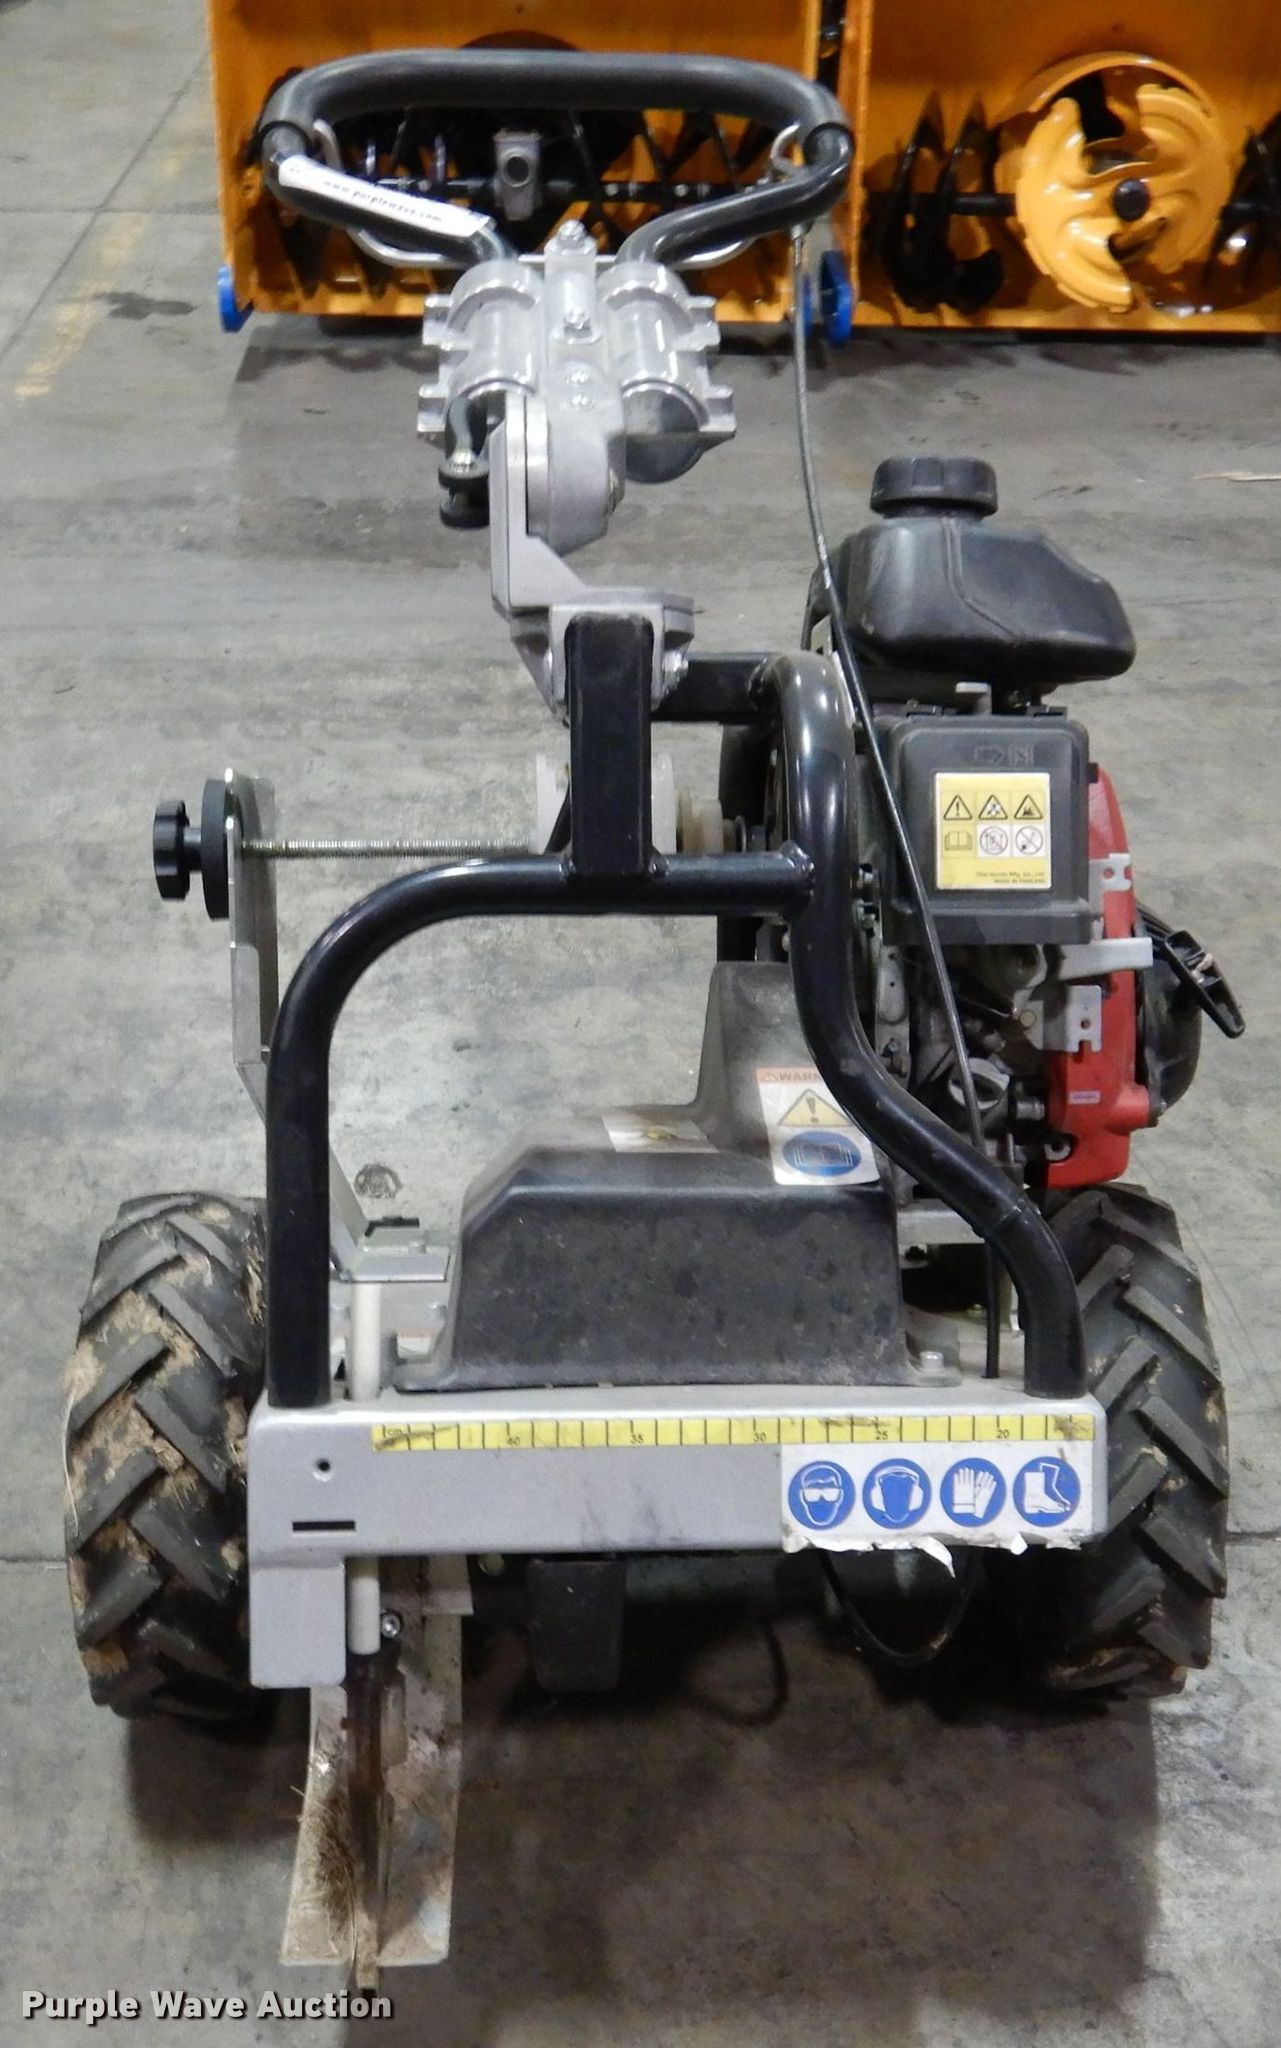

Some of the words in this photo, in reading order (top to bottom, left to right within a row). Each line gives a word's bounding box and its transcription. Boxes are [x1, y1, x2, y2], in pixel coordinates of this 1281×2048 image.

[507, 1436, 521, 1446] 40
[631, 1434, 645, 1444] 35
[753, 1432, 767, 1442] 30
[876, 1430, 889, 1440] 25
[997, 1429, 1009, 1439] 20
